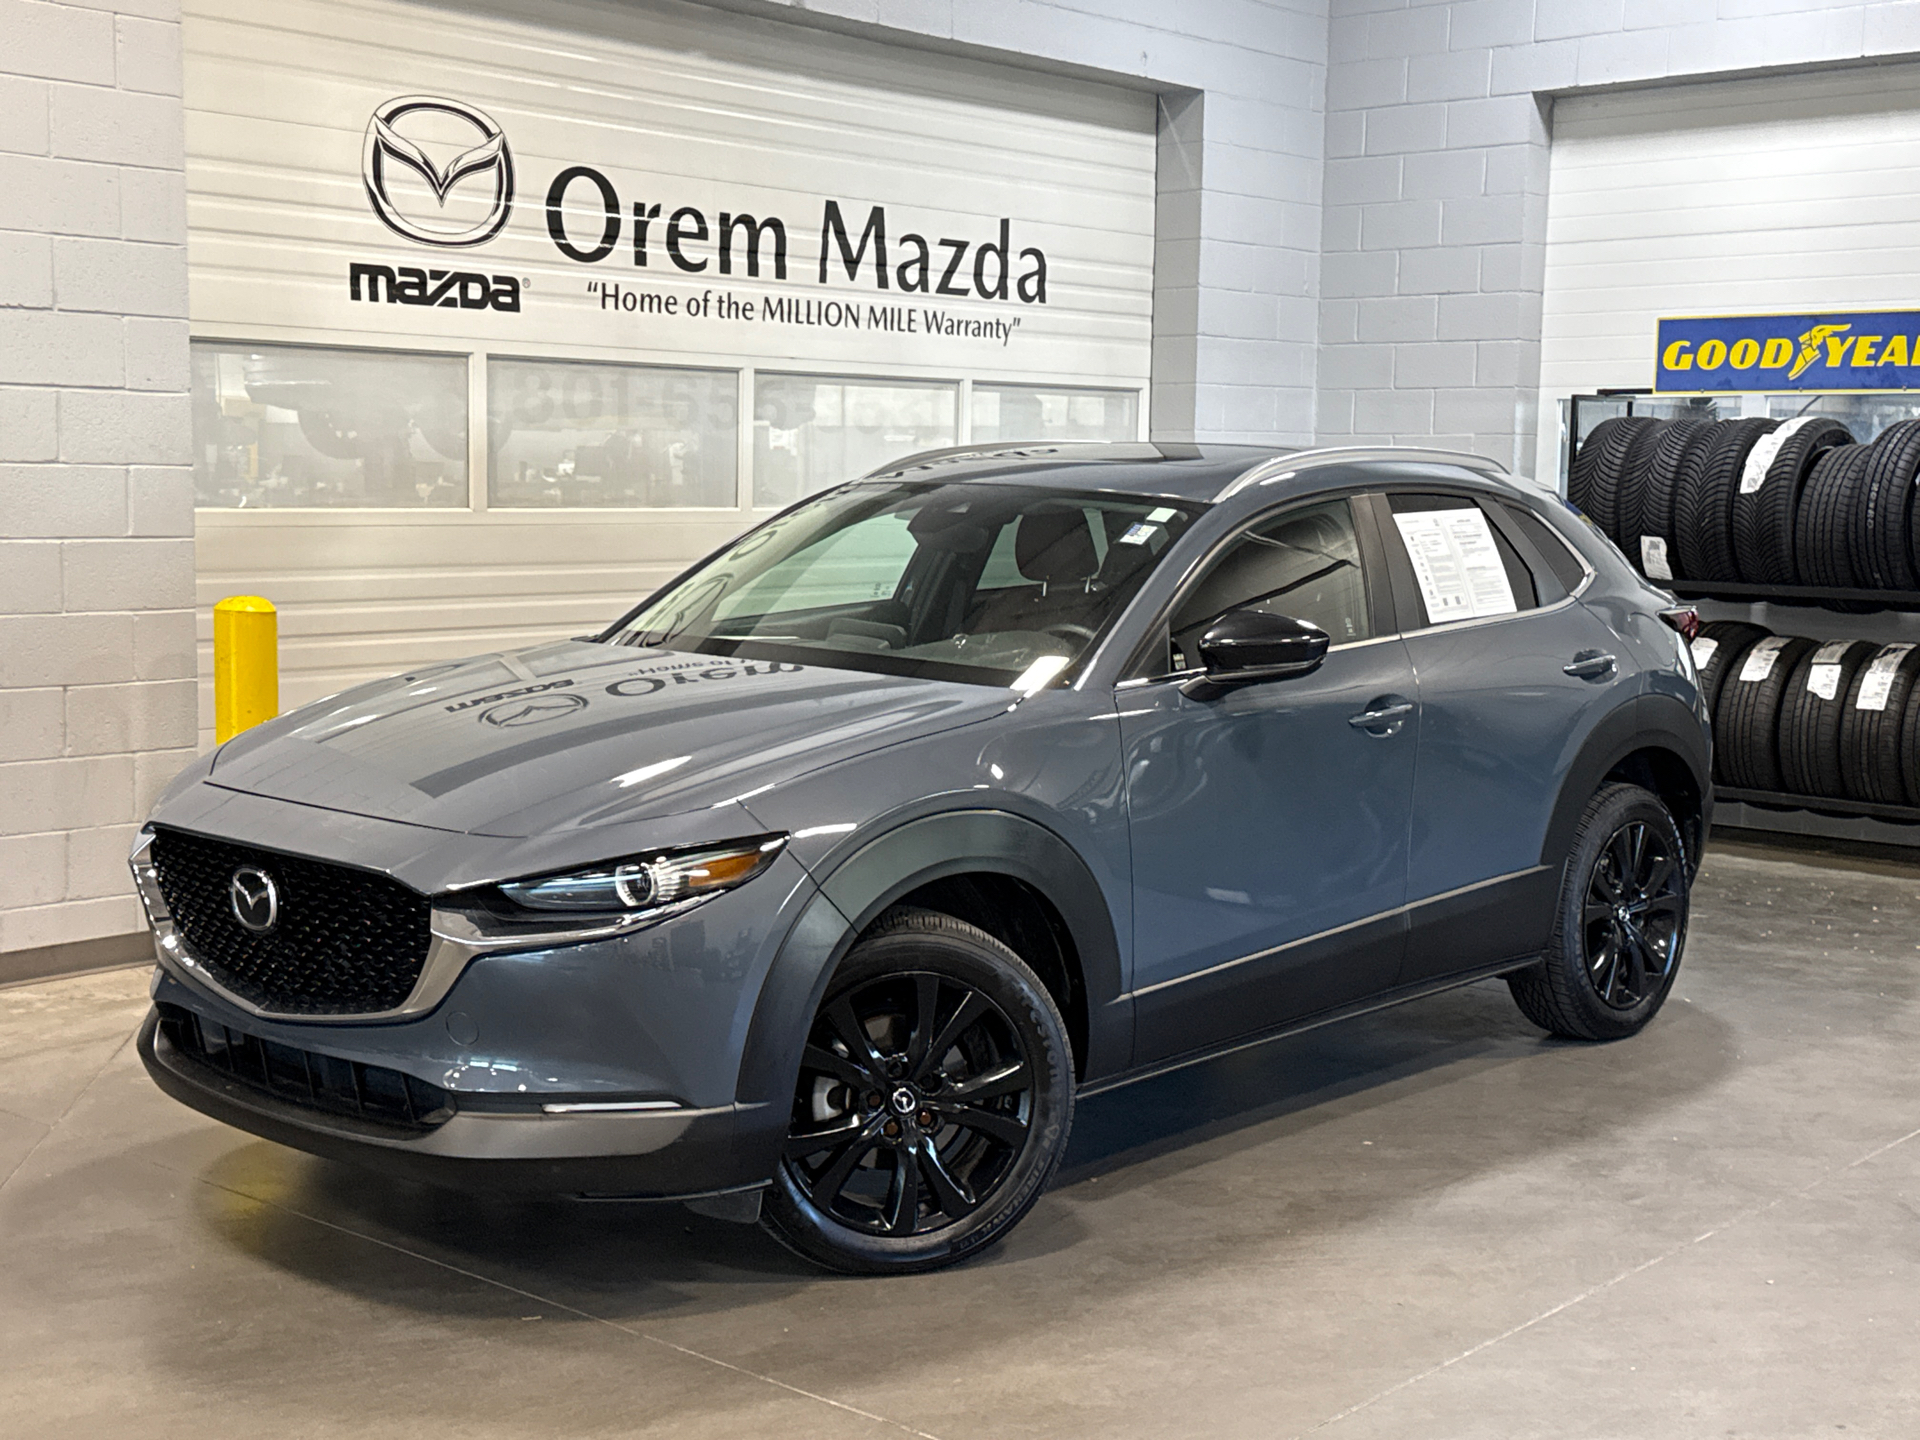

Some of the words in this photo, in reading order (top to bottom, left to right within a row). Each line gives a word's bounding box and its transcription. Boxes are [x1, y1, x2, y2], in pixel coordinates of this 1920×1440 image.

[545, 165, 787, 281] Orem
[819, 199, 1047, 304] Mazda
[349, 262, 521, 313] mazda
[586, 281, 678, 315] “Home
[686, 290, 711, 317] of
[717, 292, 755, 321] the
[762, 296, 860, 329] MILLION
[867, 305, 917, 333] MILE
